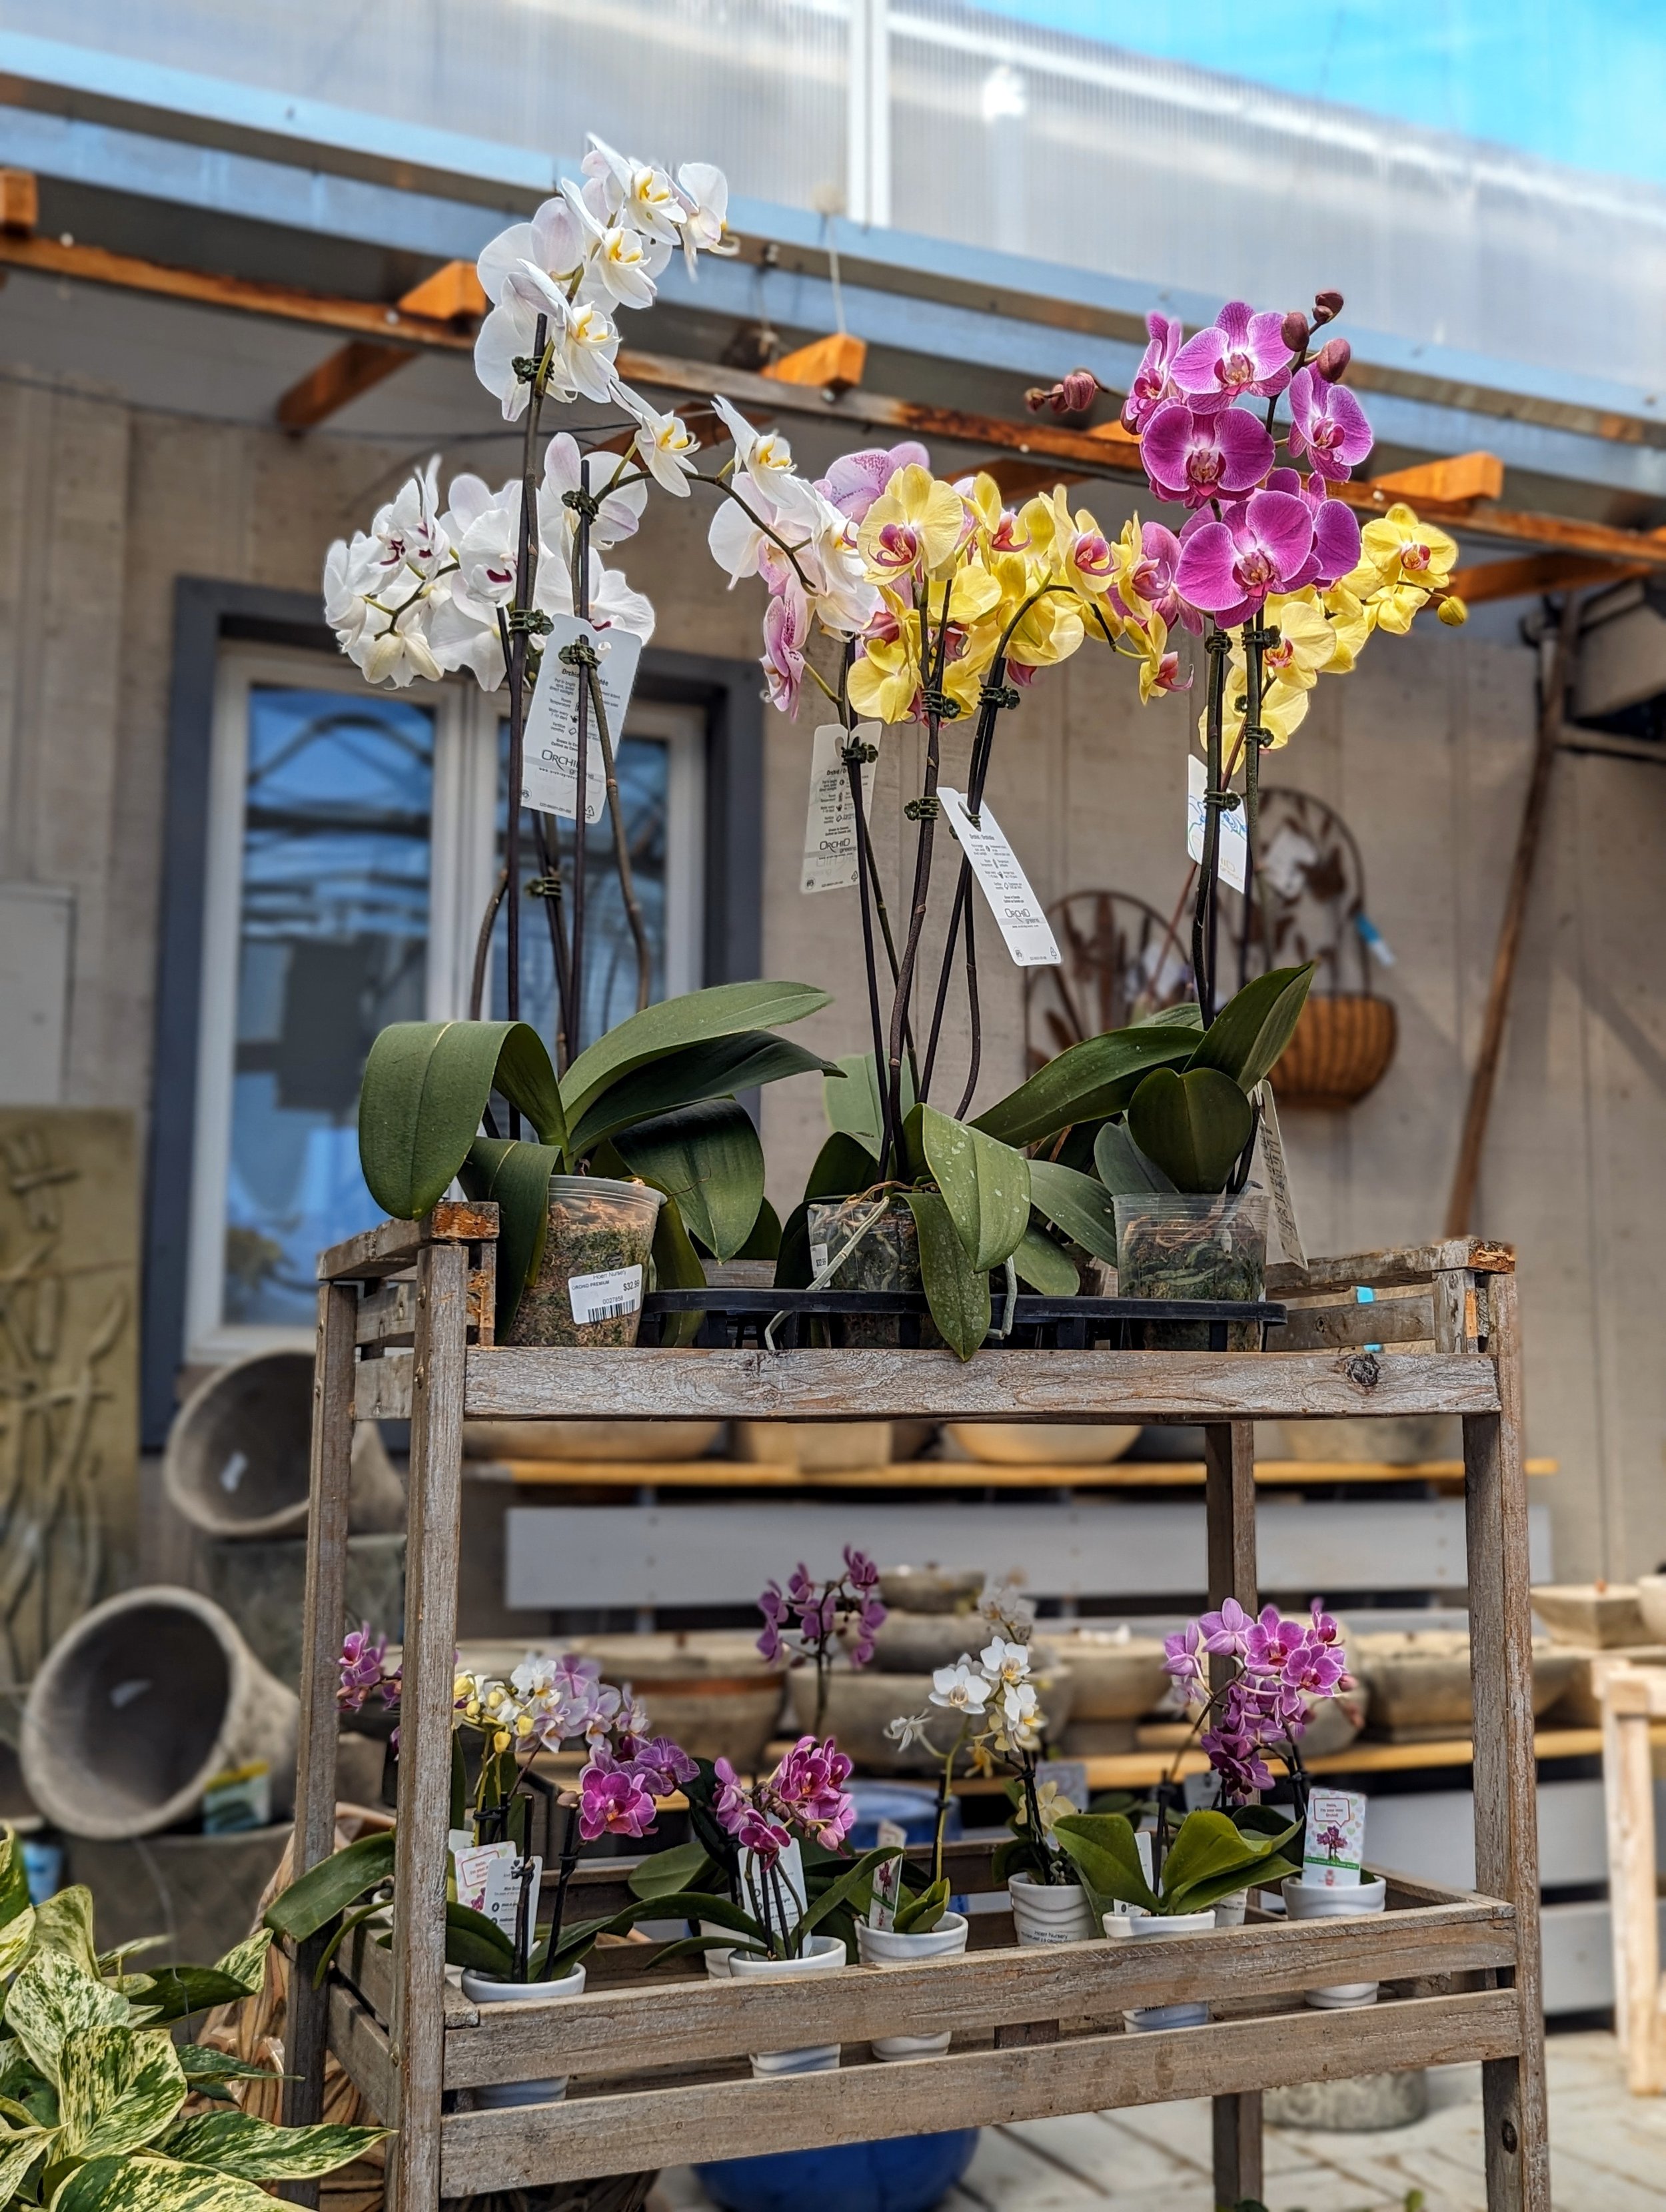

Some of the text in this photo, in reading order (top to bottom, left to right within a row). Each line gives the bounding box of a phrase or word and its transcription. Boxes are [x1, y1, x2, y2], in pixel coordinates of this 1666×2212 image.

[542, 750, 578, 772] ORCHI
[820, 838, 850, 853] ORCHID
[623, 1279, 640, 1291] $32.99
